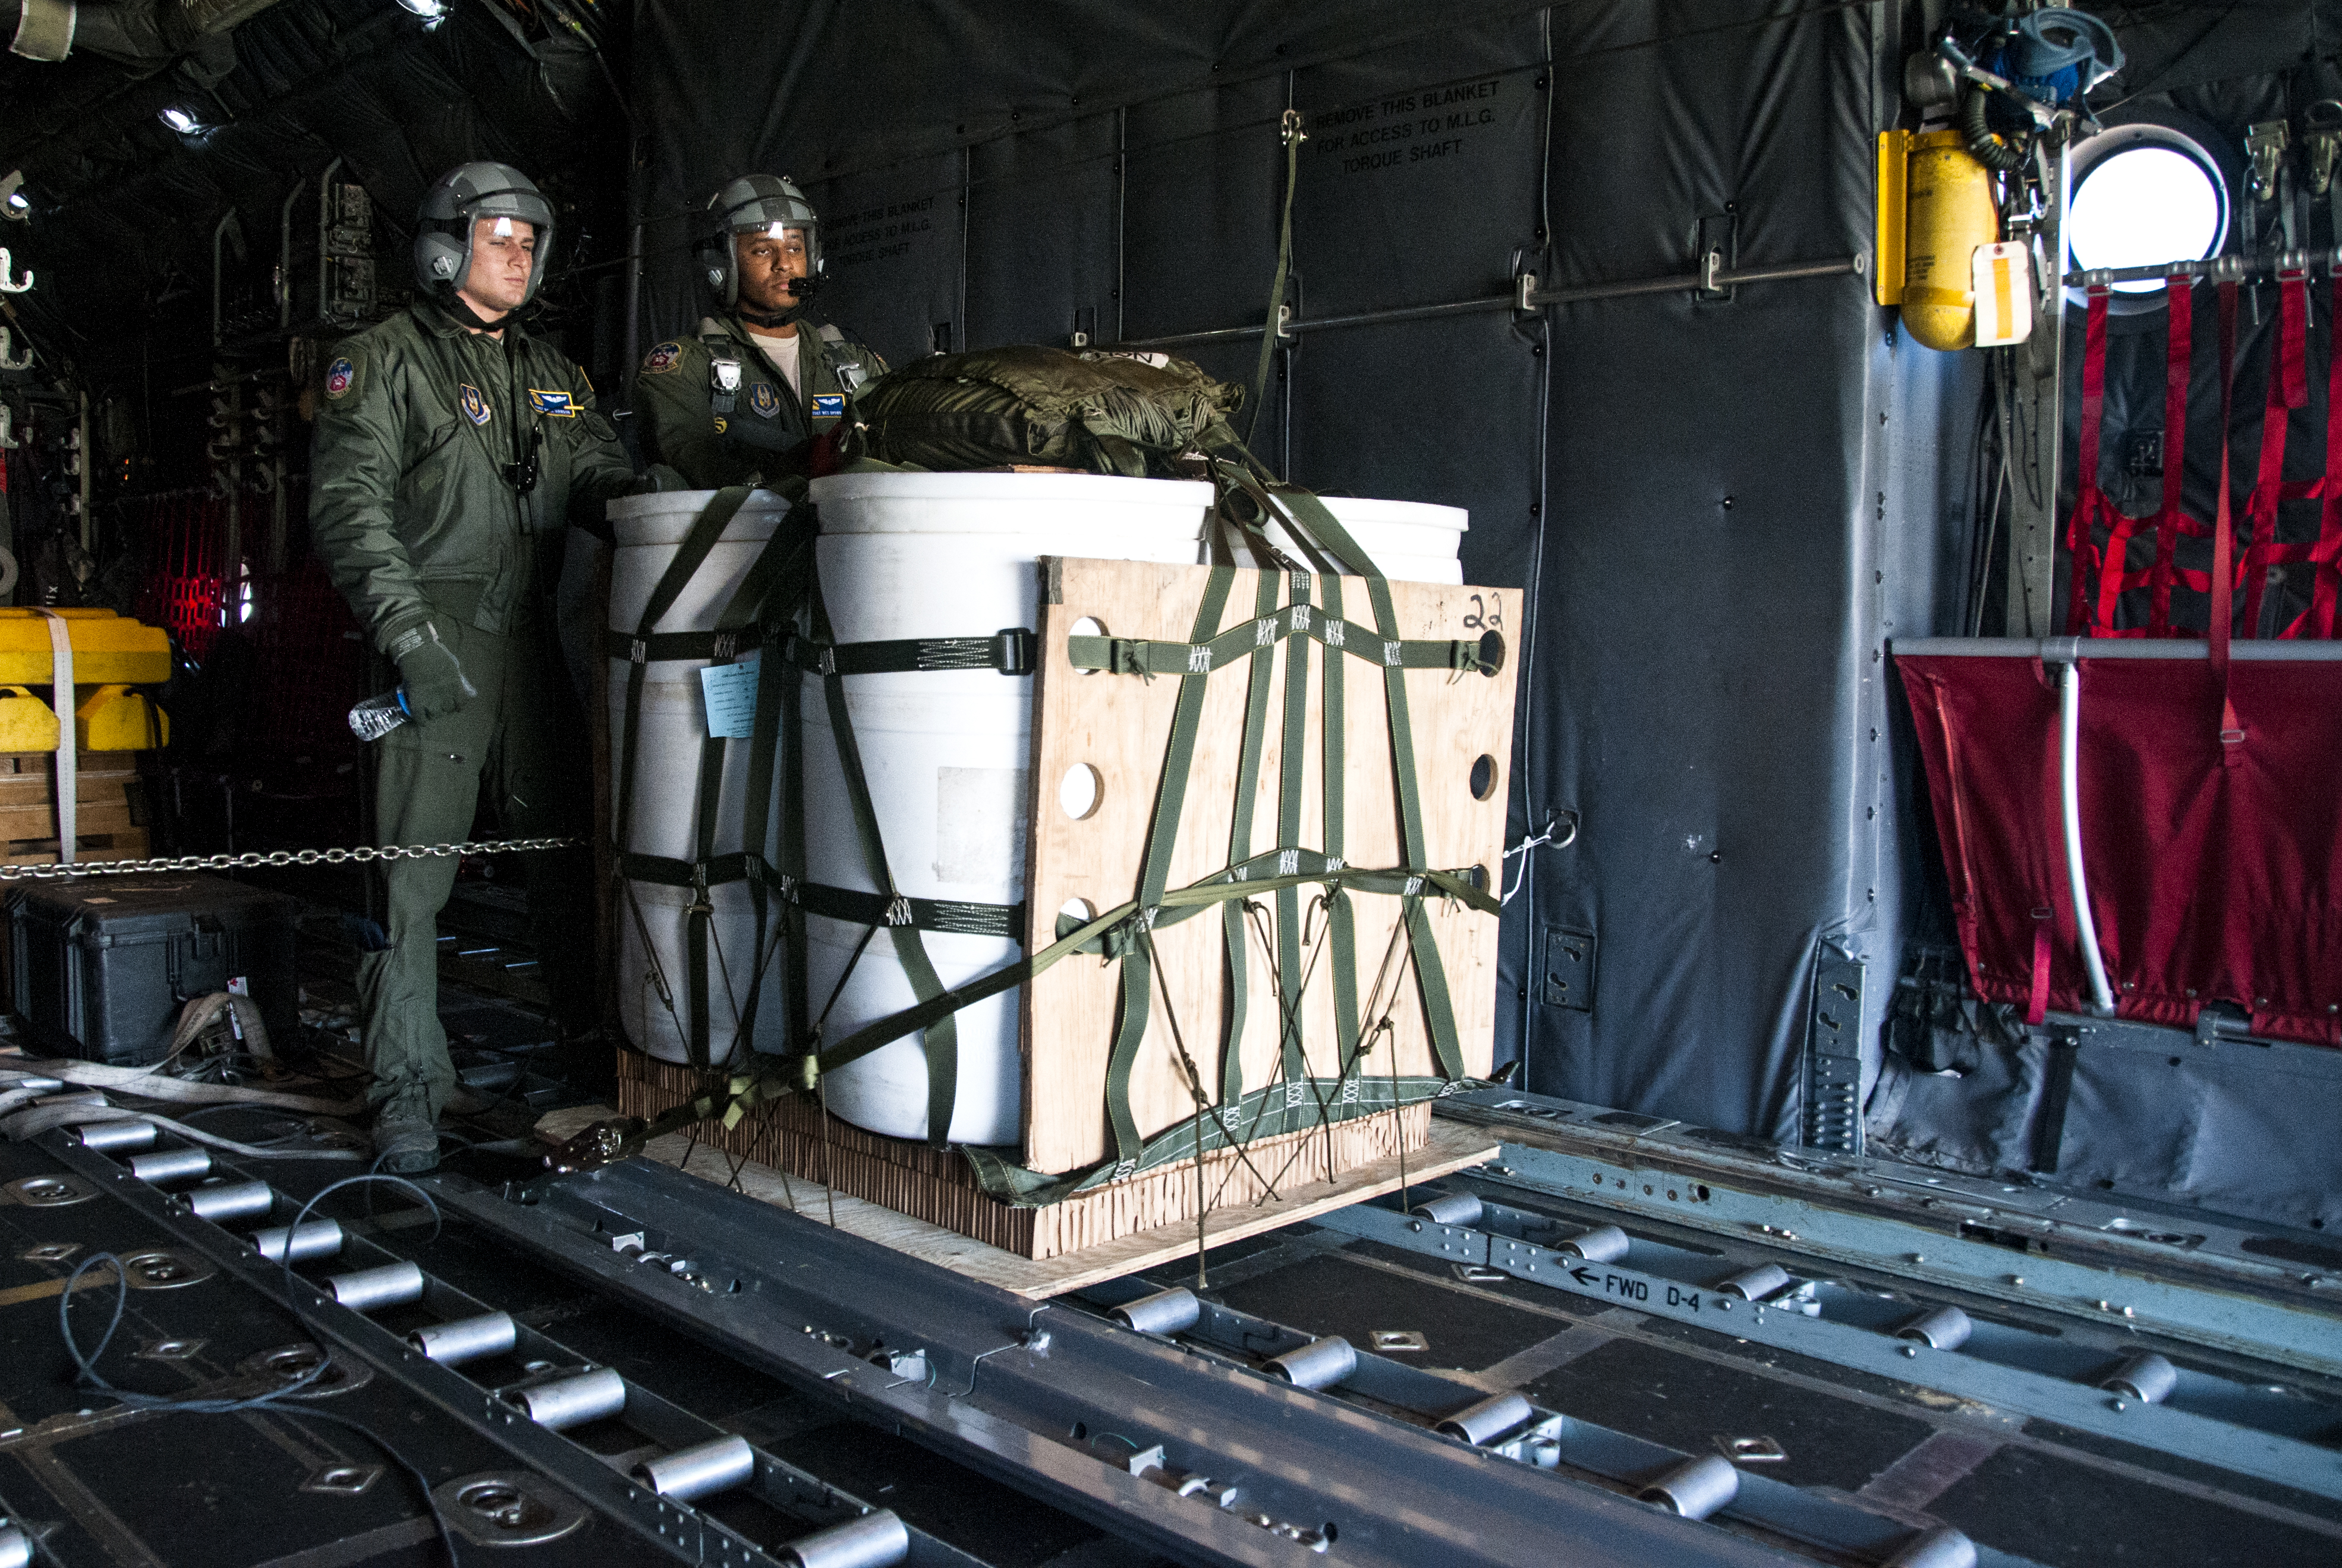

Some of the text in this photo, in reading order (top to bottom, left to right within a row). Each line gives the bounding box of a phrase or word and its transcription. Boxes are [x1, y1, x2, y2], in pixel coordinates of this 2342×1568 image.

[1315, 80, 1500, 130] REMOVE THIS BLANKET
[1317, 137, 1345, 155] FOR
[1349, 122, 1413, 147] ACCESS
[1421, 118, 1440, 134] TO
[1342, 138, 1463, 174] TORQUE SHAFT
[887, 196, 935, 218] BLANKET
[1606, 1274, 1699, 1312] FWD D-4
